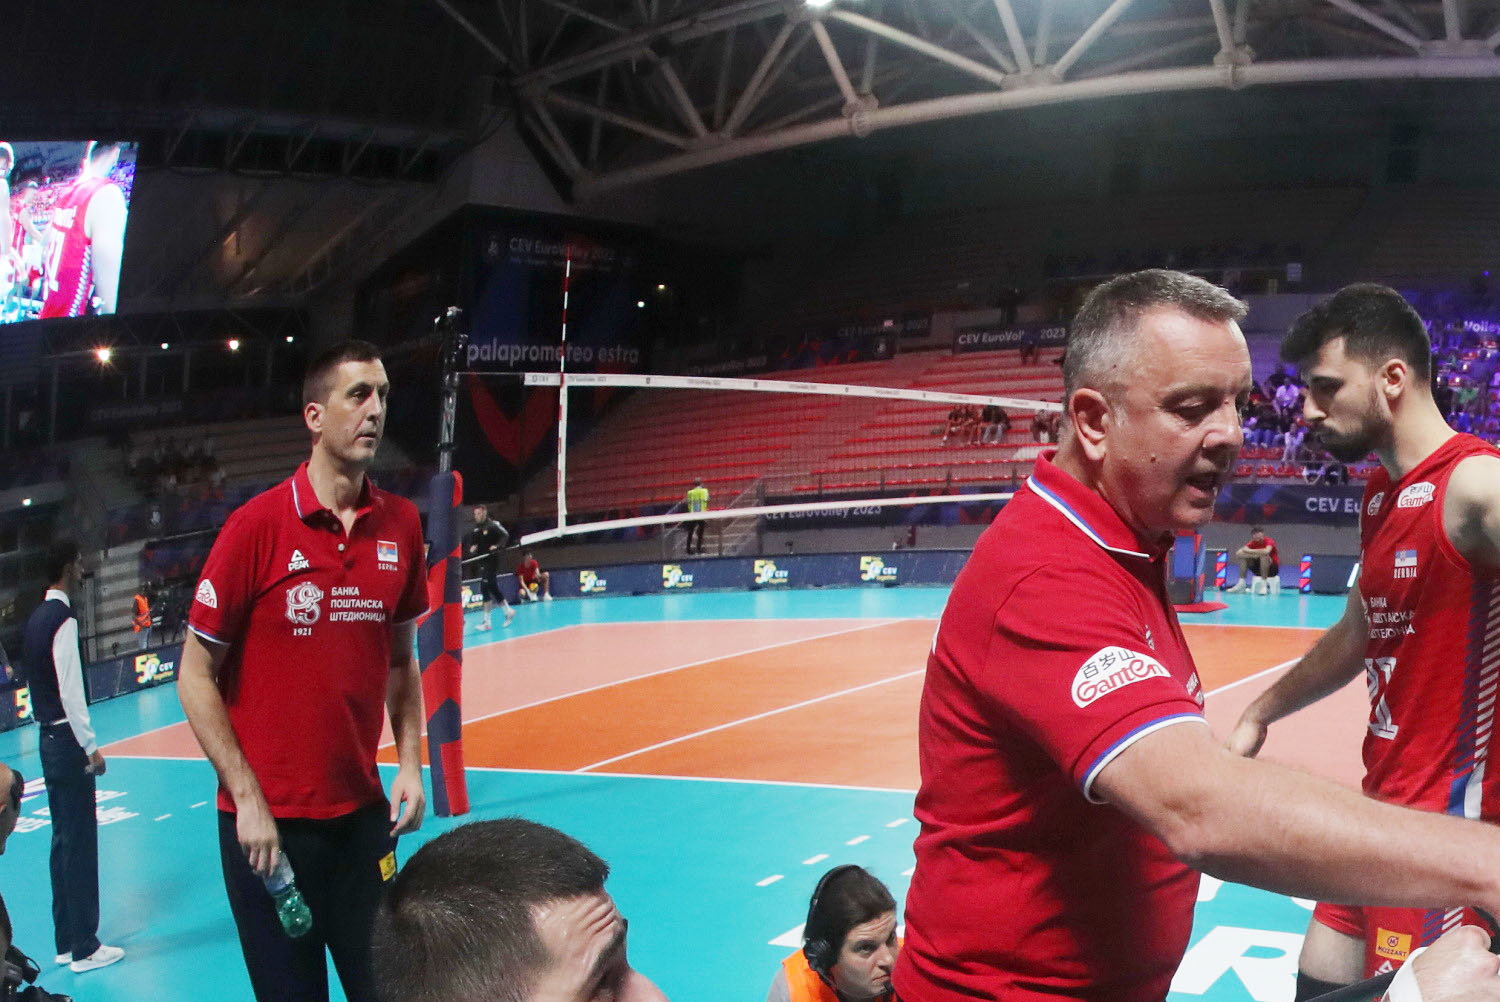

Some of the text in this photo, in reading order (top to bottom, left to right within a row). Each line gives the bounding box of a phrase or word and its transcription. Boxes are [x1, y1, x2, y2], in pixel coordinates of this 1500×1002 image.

[958, 333, 980, 345] CEV
[1039, 327, 1066, 339] 2023
[1305, 497, 1340, 513] CEV
[1343, 498, 1361, 513] Eu
[287, 559, 310, 572] PEAK
[882, 566, 898, 575] CEV
[774, 570, 789, 578] CEV
[331, 586, 360, 597] БАНКА
[330, 598, 384, 609] ПОШТАНСКА
[329, 610, 386, 623] ШТЕДИОНИЦА
[293, 627, 313, 636] 1921
[1081, 650, 1136, 679] 百岁山
[1076, 659, 1165, 702] Ganten
[1377, 945, 1408, 958] MOZZART
